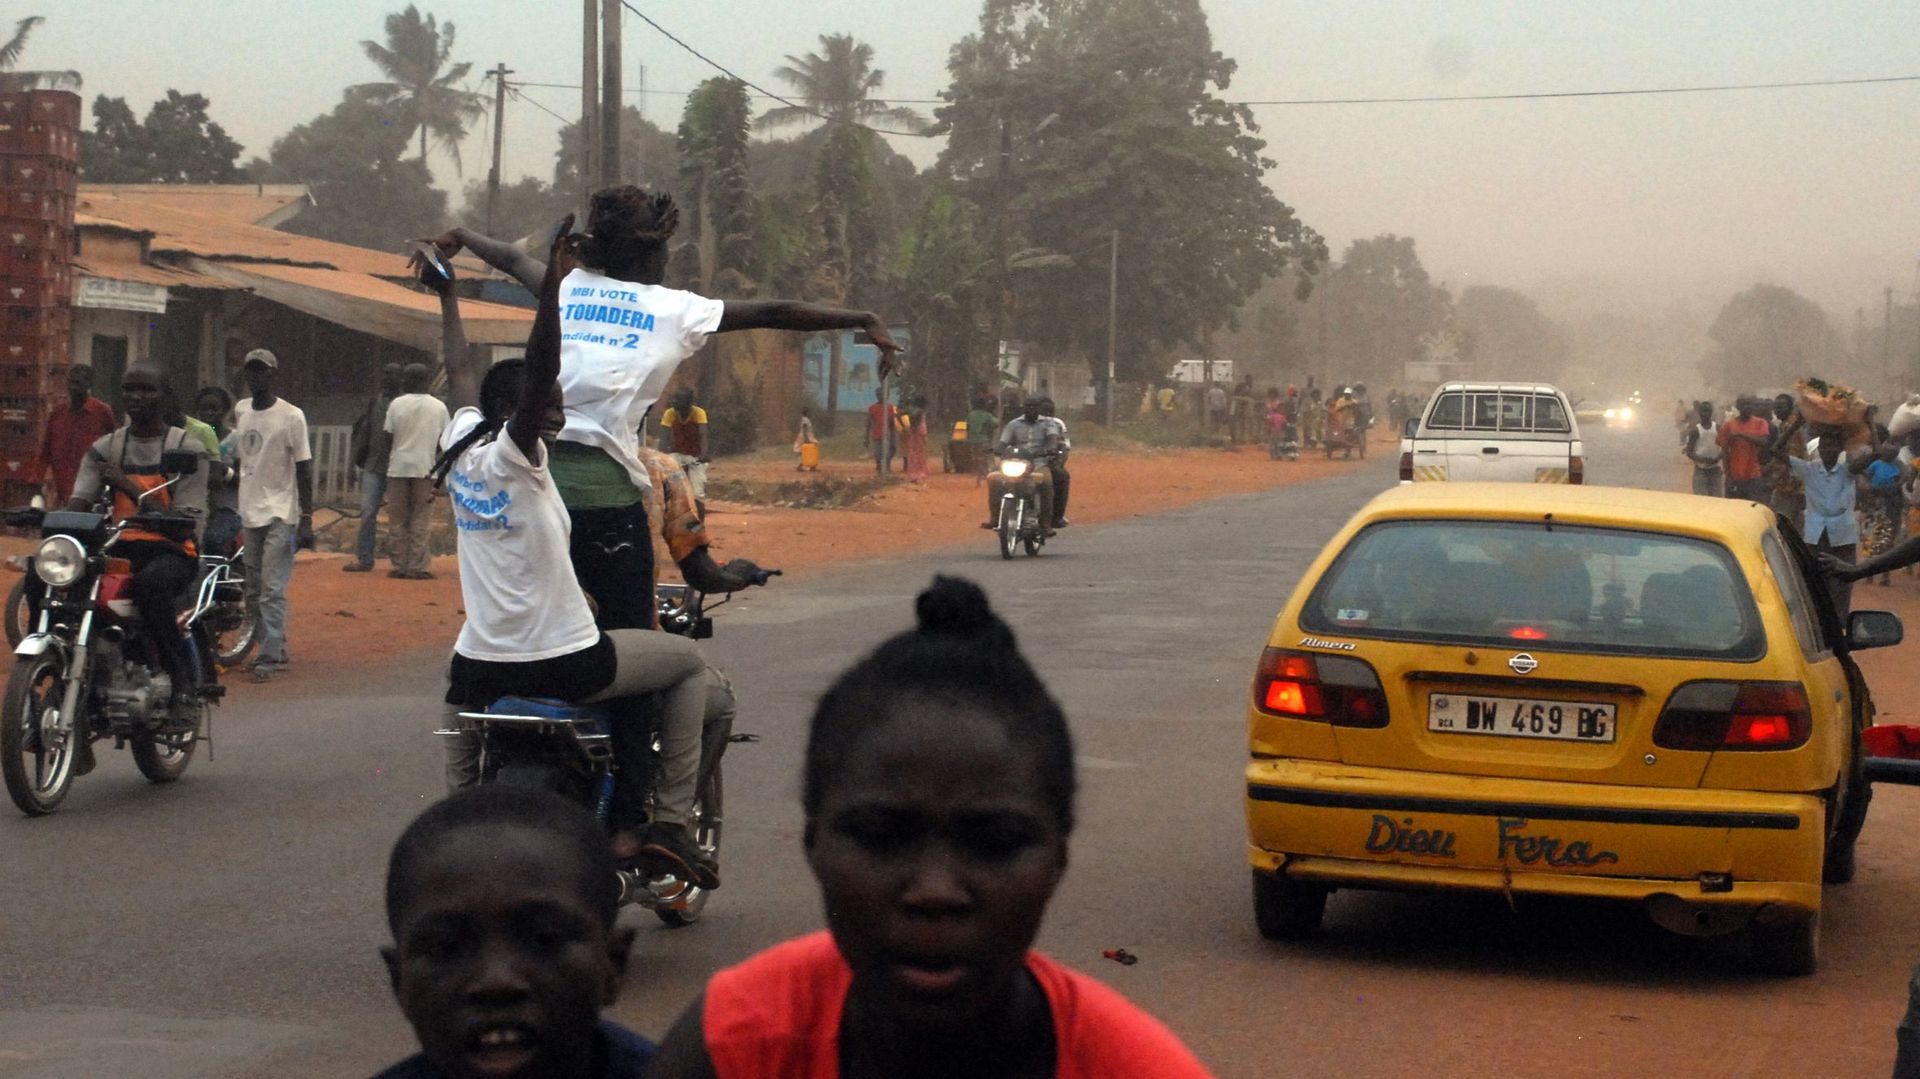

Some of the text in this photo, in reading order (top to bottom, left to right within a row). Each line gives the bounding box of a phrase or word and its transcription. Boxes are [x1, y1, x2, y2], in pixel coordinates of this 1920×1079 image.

[570, 287, 639, 303] MBI VOTE
[565, 304, 655, 332] TOUADERA
[1298, 637, 1357, 651] Almera
[1511, 704, 1562, 734] 469
[1578, 707, 1607, 738] BG
[1365, 814, 1619, 866] Dieu Fera
